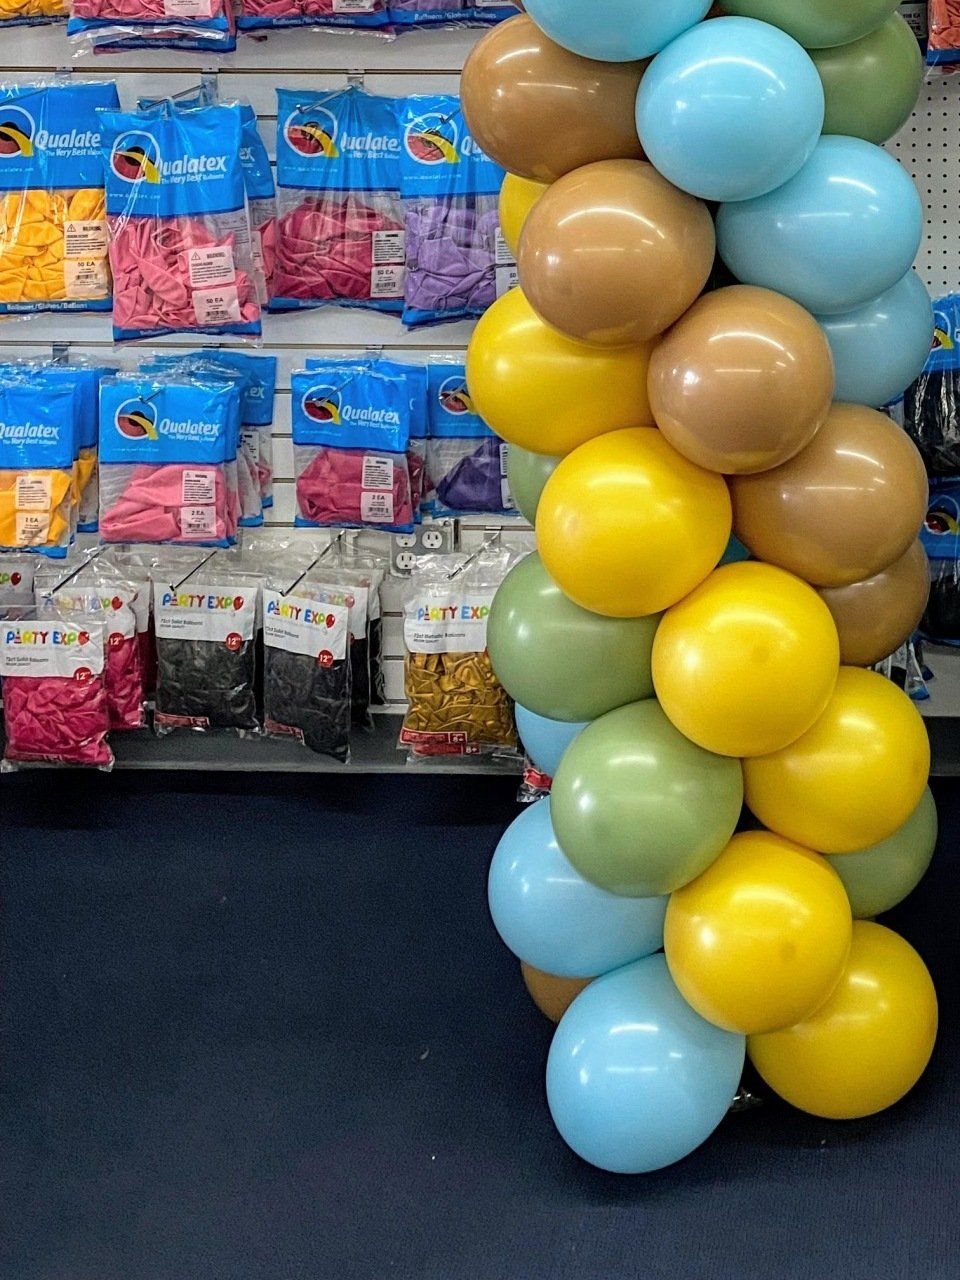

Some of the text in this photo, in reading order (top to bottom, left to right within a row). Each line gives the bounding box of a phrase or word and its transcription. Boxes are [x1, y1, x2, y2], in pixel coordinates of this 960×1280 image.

[35, 130, 99, 150] Qualate
[56, 148, 87, 158] Very Best
[170, 176, 186, 186] Very
[342, 405, 400, 424] Qualatex
[0, 423, 60, 440] Qualatex
[160, 418, 219, 436] Qualatex
[162, 592, 205, 608] PARTY
[267, 599, 302, 620] PARTY
[417, 606, 457, 621] PARTY
[6, 629, 48, 645] PARTY
